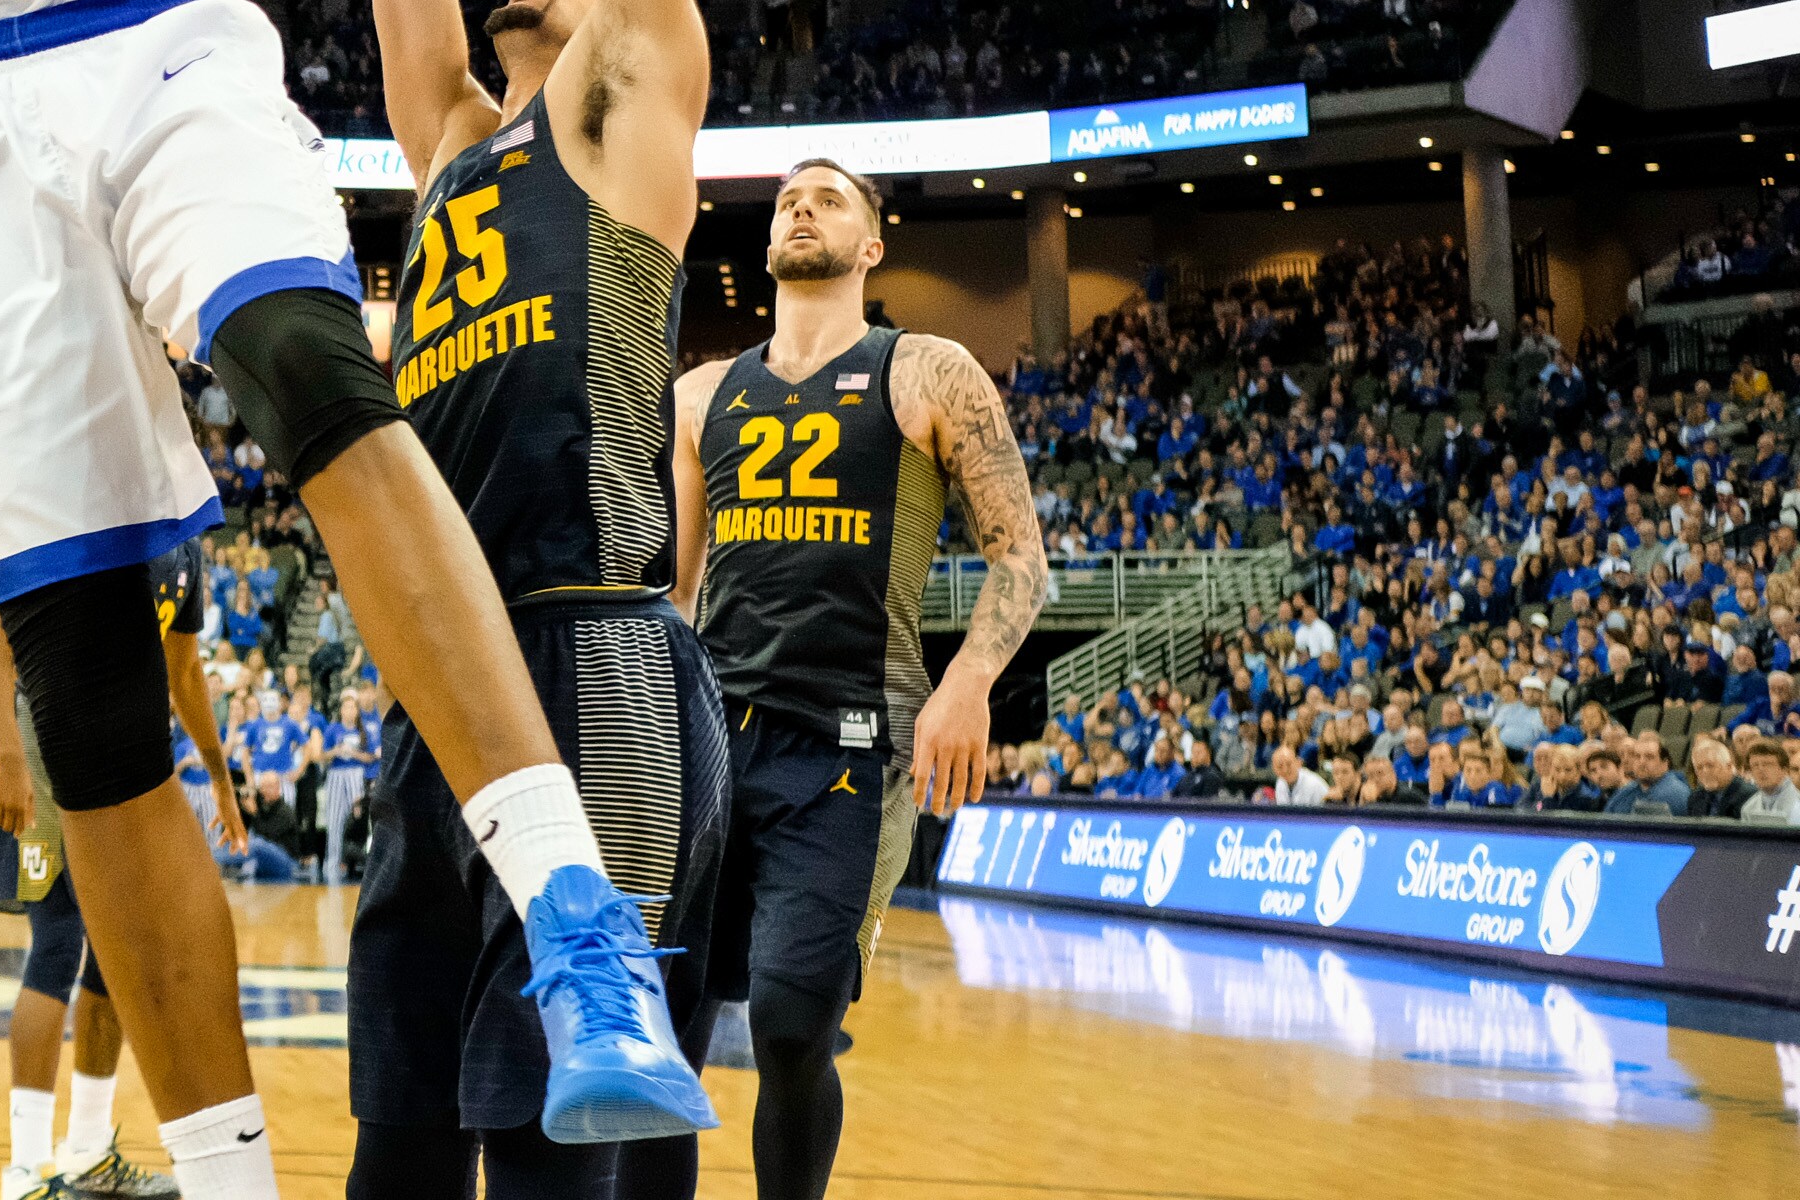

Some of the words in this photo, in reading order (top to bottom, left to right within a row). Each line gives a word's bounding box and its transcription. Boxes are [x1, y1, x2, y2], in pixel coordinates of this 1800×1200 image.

[1067, 121, 1152, 157] AQUAFINA
[1164, 112, 1192, 136] FOR
[1195, 108, 1237, 133] HAPPY
[1240, 101, 1295, 128] BODIES
[408, 184, 508, 342] 25
[737, 412, 840, 500] 22
[715, 506, 871, 545] MARQUETTE
[22, 845, 48, 880] MU
[1062, 817, 1149, 871] SilverStone
[1209, 825, 1317, 885] SilverStone
[1100, 874, 1138, 899] GROUP
[1398, 839, 1537, 908] SilverStone
[1260, 889, 1306, 917] GROUP
[1466, 912, 1524, 943] GROUP
